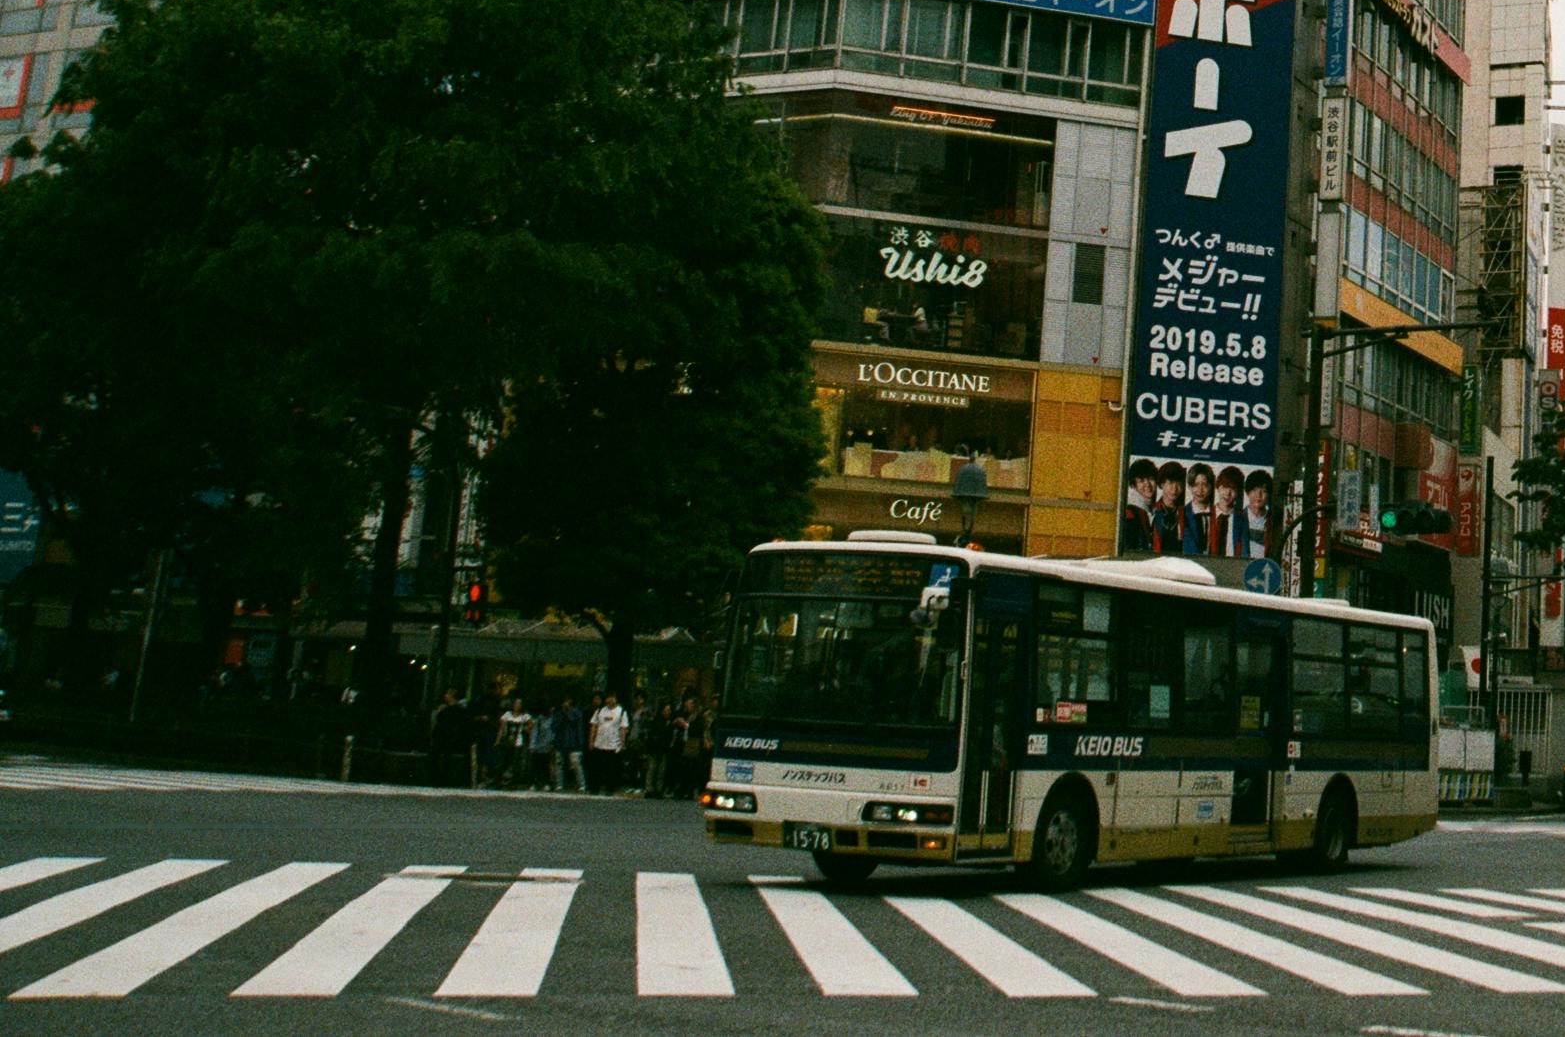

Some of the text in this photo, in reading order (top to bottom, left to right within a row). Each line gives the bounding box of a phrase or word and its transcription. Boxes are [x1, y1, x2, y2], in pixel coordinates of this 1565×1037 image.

[1325, 105, 1340, 193] 渋谷駅前ビル
[889, 225, 935, 249] 渋谷
[879, 244, 988, 289] Ushi8
[1157, 254, 1266, 288] メジャー
[1152, 282, 1262, 321] デビュー!!
[1149, 324, 1267, 360] 2019.5.8
[1551, 323, 1565, 354] 免税
[857, 362, 991, 393] L'OCCITANE
[1149, 352, 1265, 387] Release
[1463, 369, 1479, 402] レイク
[901, 393, 967, 407] PROVENCE
[1135, 391, 1272, 430] CUBERS
[1155, 429, 1256, 453] キューバーズ
[889, 498, 943, 525] Café
[1413, 589, 1450, 631] LUSH
[724, 736, 780, 751] KEIO BUS
[1075, 735, 1145, 757] KEIO BUS
[782, 769, 847, 785] ノンステップバス
